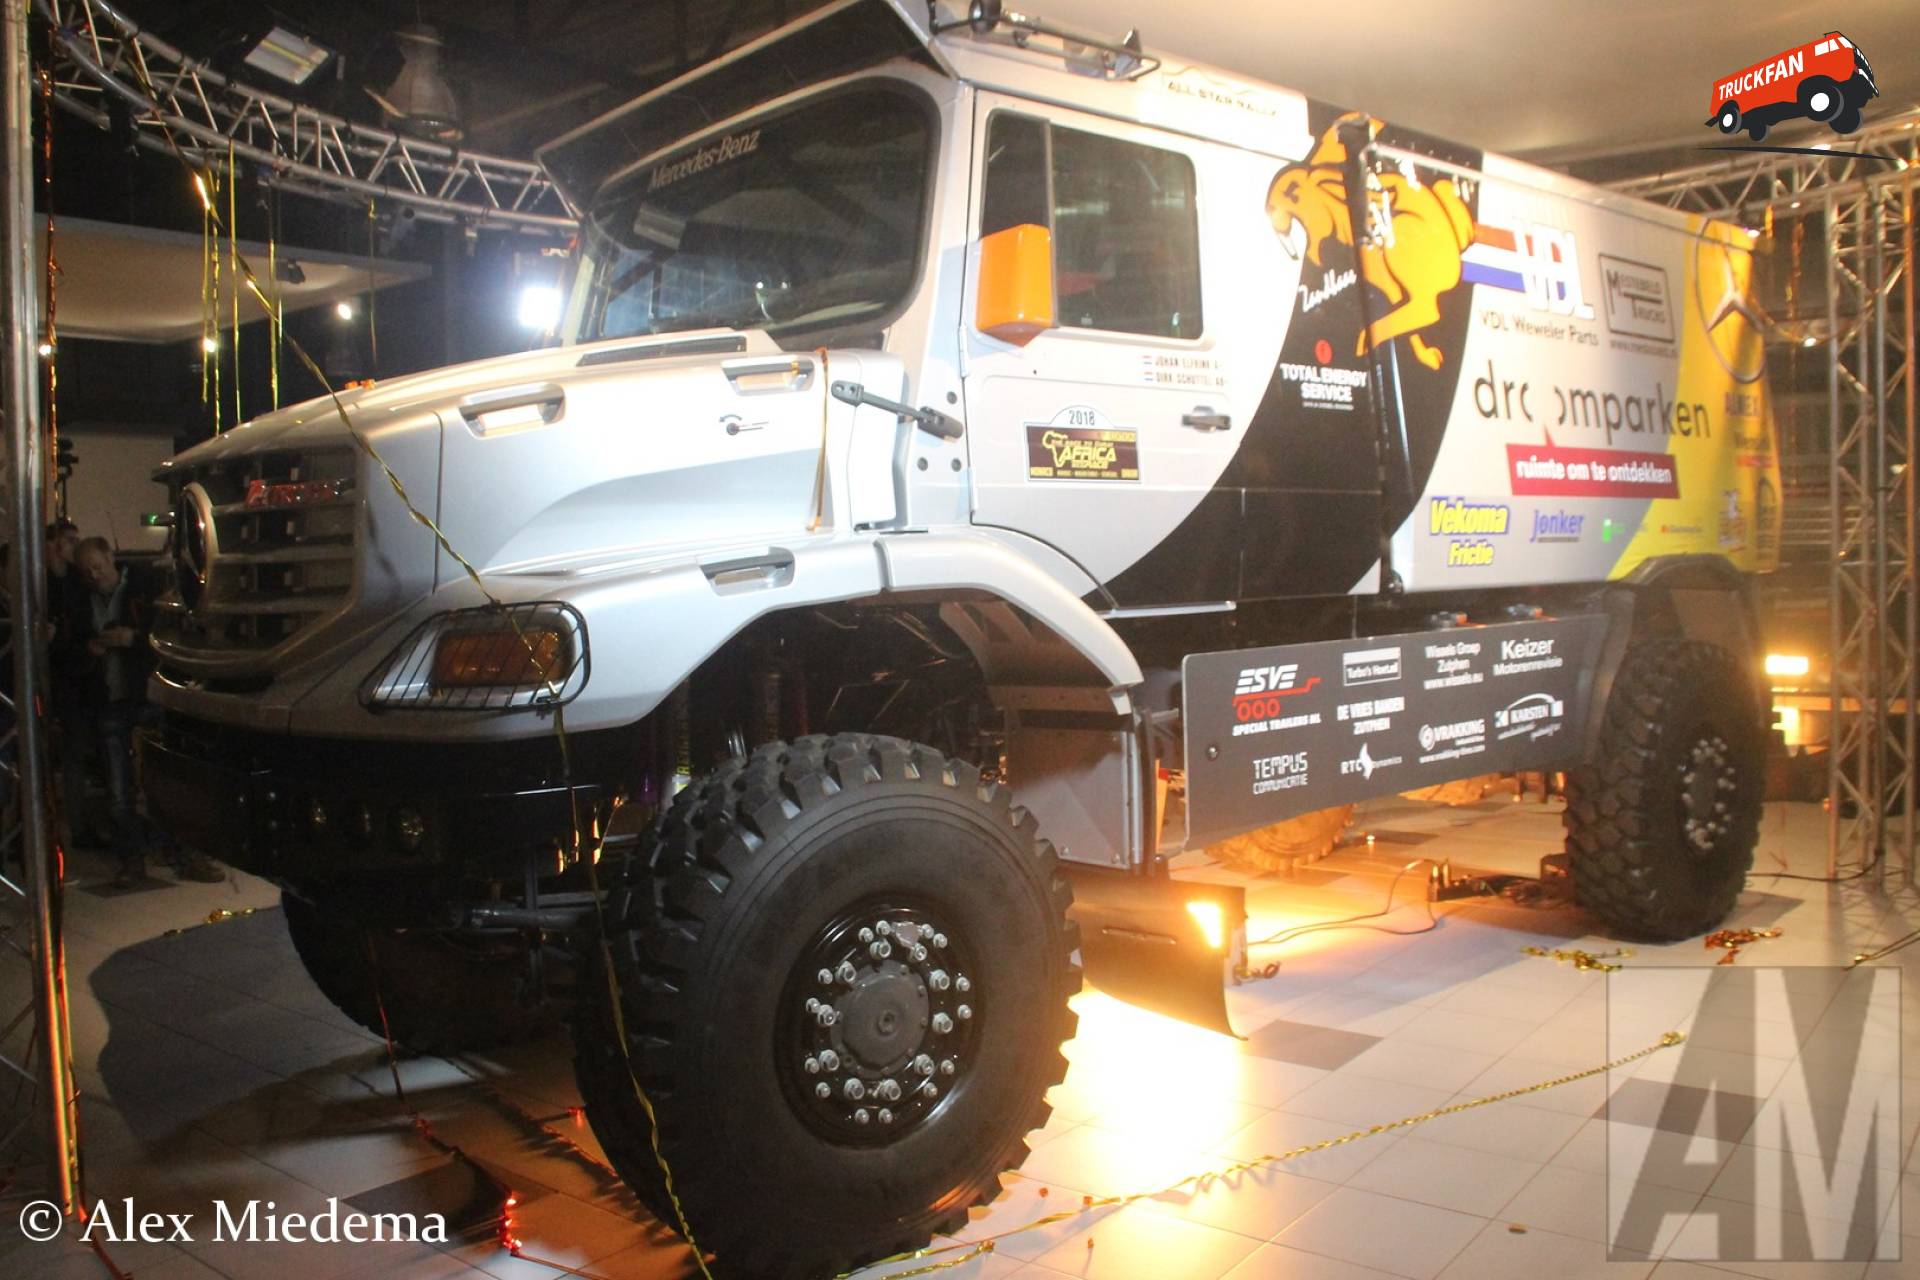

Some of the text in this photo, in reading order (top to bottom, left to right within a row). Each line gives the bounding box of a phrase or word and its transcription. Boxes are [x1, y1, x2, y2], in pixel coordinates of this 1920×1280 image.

[648, 129, 762, 190] Mercedes-Benz
[1480, 309, 1509, 331] VDL
[1568, 323, 1600, 347] Parts
[1280, 363, 1320, 383] TOTAL
[1301, 382, 1353, 402] SERVICE
[1069, 410, 1096, 426] 2018
[1059, 446, 1117, 463] AFRICA
[1516, 454, 1673, 484] ruimte om te ontdekken
[1429, 496, 1511, 537] Vekoma
[1501, 638, 1556, 661] Keizer
[1234, 663, 1299, 696] ESVE
[1232, 720, 1268, 737] SPECIAL
[1434, 718, 1486, 743] VRAKKING
[1253, 751, 1308, 779] TEMPUS
[1340, 760, 1364, 775] RTC
